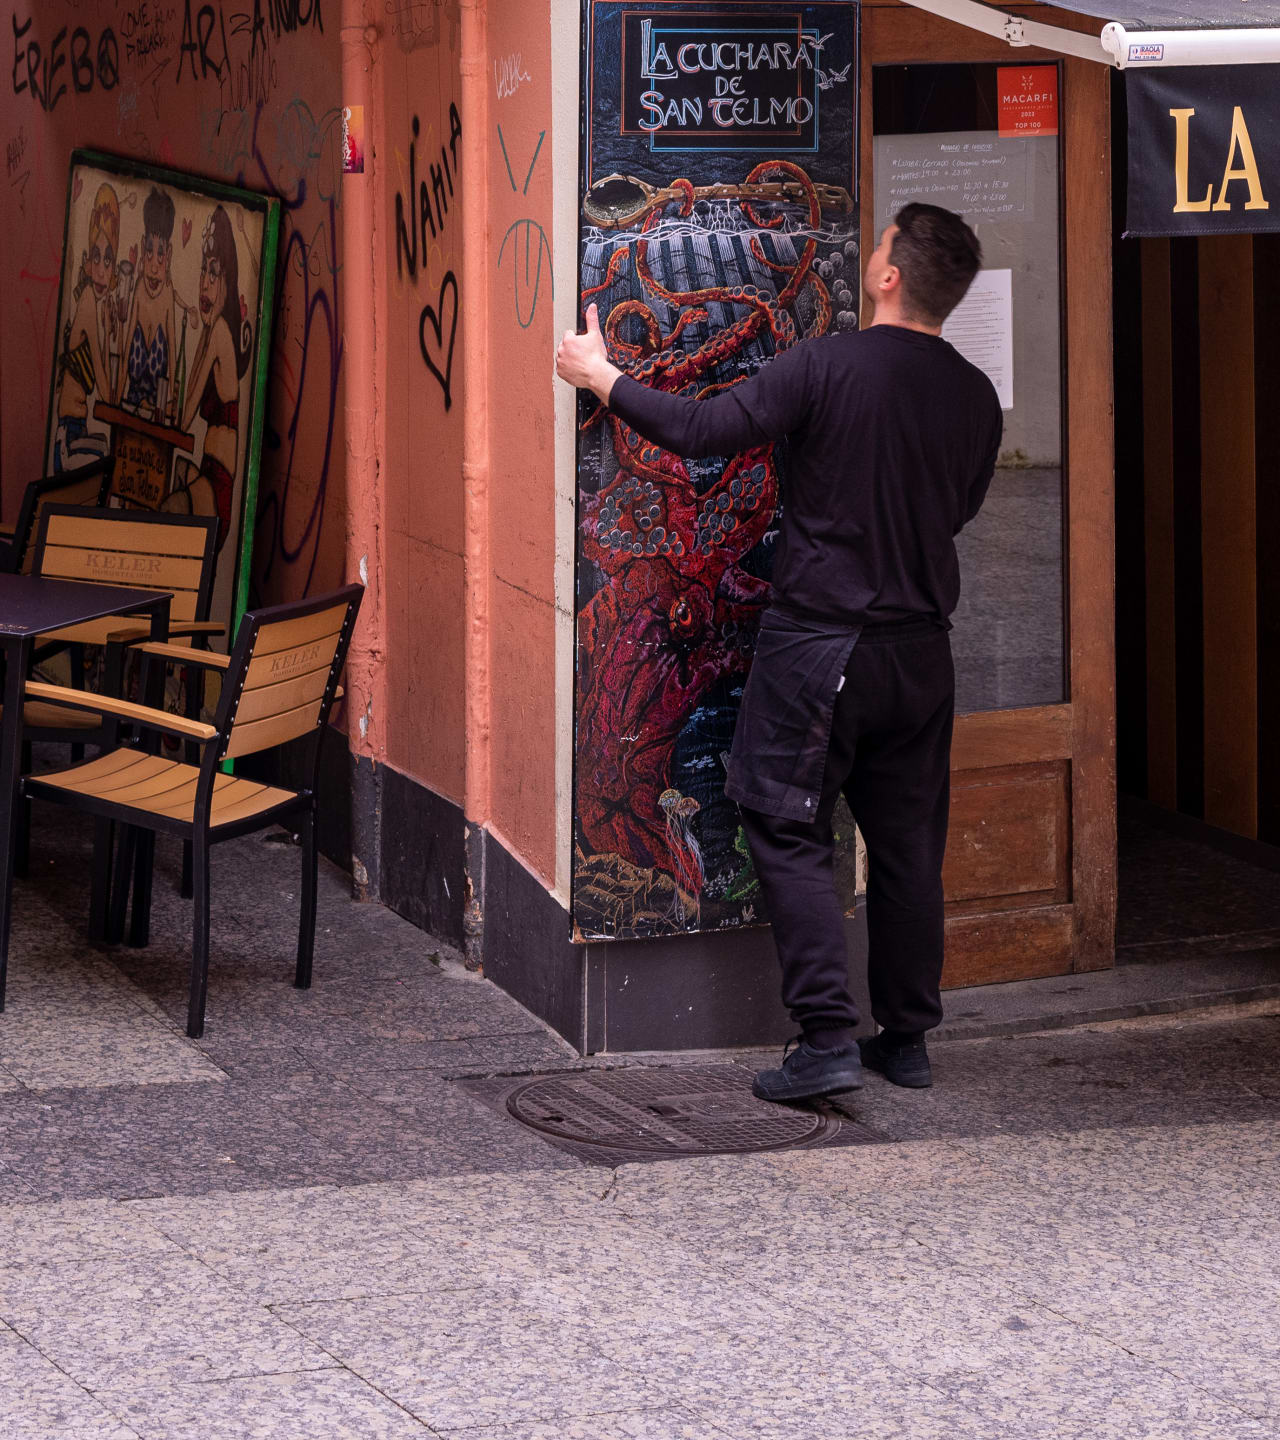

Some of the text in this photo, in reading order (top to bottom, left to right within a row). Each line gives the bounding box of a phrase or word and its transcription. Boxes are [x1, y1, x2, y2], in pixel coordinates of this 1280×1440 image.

[641, 18, 813, 79] LA CUCHARA
[715, 75, 746, 97] DE
[1003, 93, 1053, 103] MACARFI
[638, 91, 814, 131] SAN TELMO
[1169, 105, 1270, 214] LA
[84, 554, 162, 573] KELER
